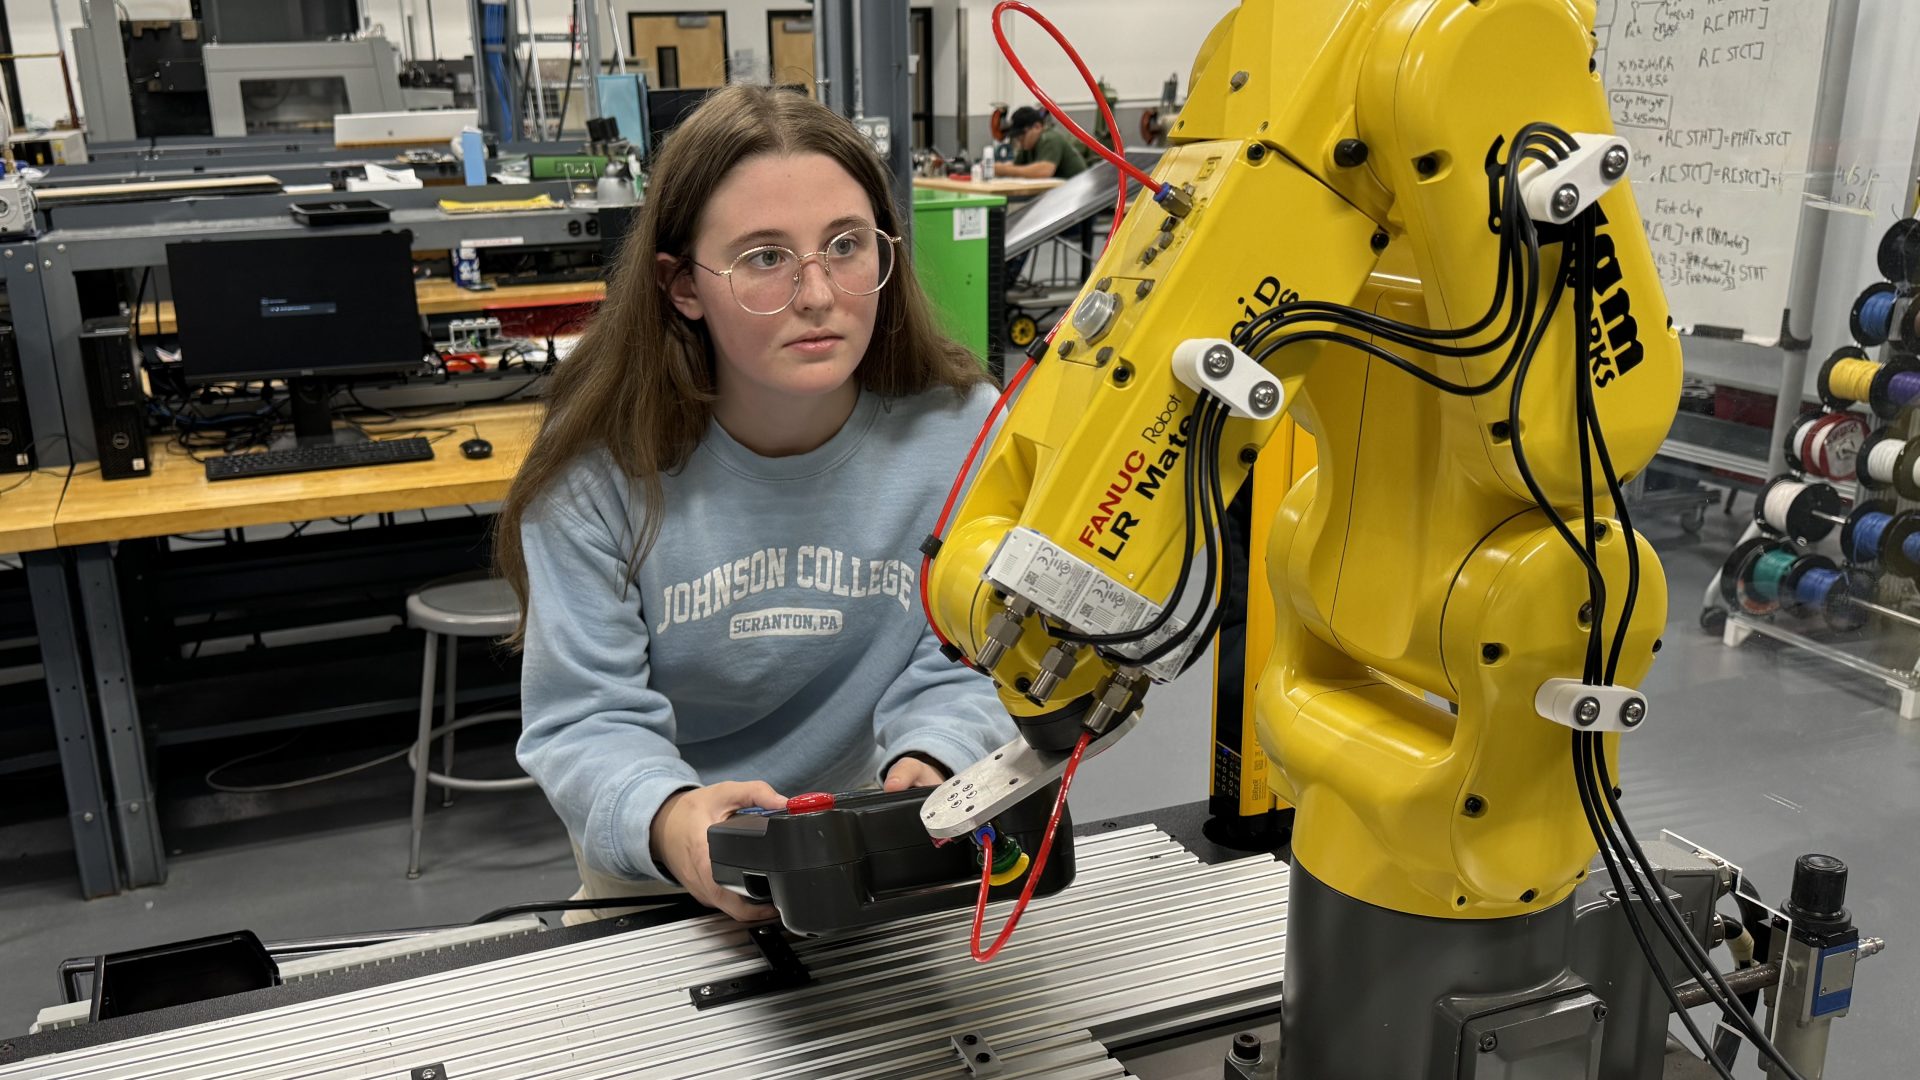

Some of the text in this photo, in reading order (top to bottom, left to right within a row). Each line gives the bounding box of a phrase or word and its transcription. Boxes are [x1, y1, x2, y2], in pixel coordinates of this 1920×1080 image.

[1078, 450, 1146, 549] FANUC
[1141, 393, 1182, 444] Robot
[1098, 511, 1141, 562] LR
[1134, 415, 1194, 501] Mate
[656, 545, 915, 635] JOHNSON COLLEGE
